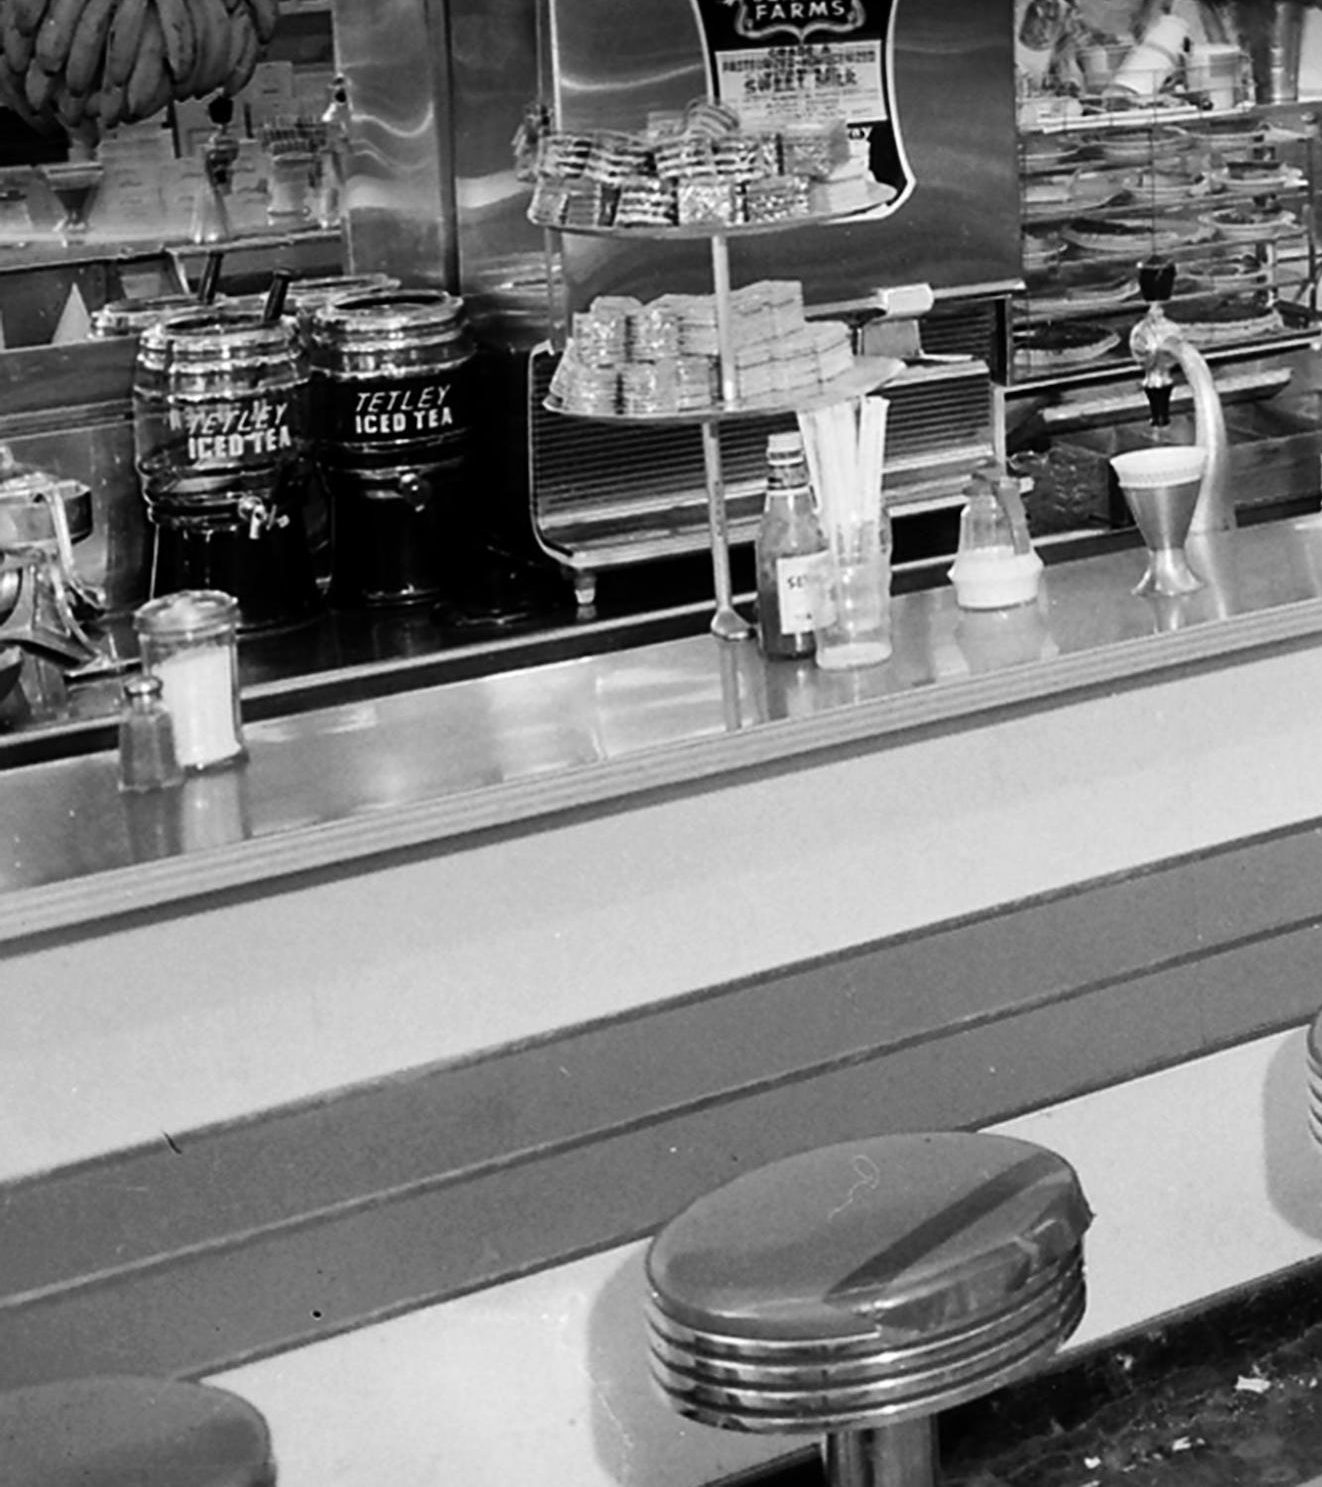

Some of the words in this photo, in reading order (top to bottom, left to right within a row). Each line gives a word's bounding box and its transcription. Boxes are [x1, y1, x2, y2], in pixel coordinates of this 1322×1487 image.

[755, 0, 845, 21] FARMS
[355, 384, 450, 413] TETLEY
[187, 402, 288, 435] TETLEY
[355, 413, 406, 434] ICED
[413, 407, 453, 430] TEA
[187, 433, 244, 460] ICED
[245, 425, 291, 454] TEA
